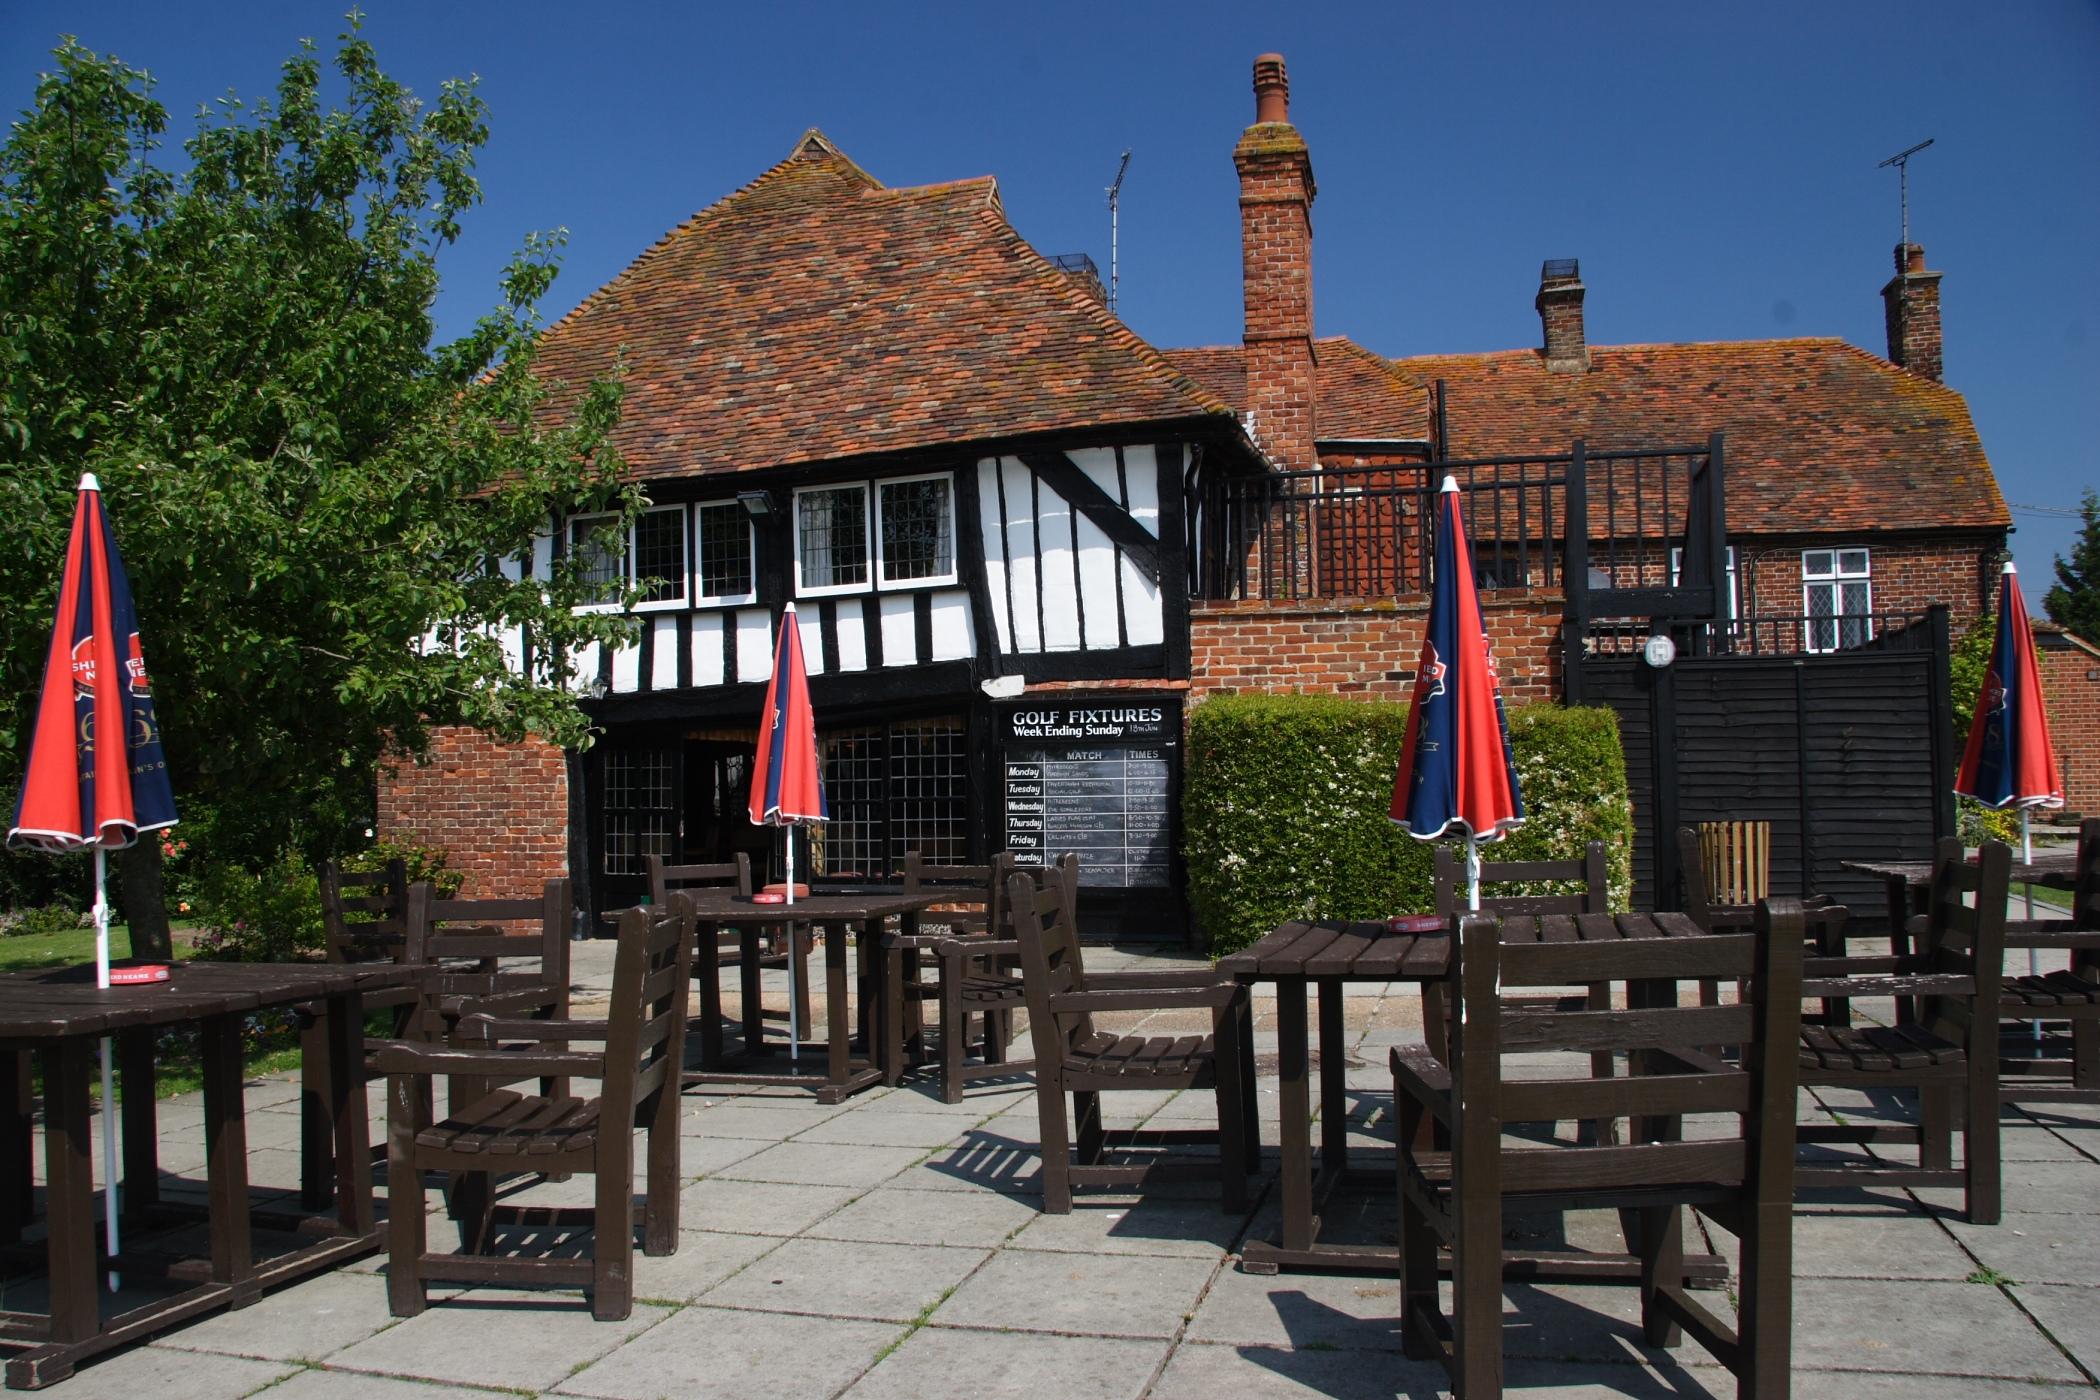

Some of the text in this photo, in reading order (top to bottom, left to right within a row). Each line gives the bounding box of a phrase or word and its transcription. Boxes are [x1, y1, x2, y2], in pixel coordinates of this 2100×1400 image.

[1013, 707, 1163, 725] GOLF FIXTURES
[1013, 723, 1124, 738] Week Ending Sunday
[1066, 751, 1102, 760] MATCH
[1130, 750, 1160, 759] TIMES
[1008, 766, 1040, 779] Monday
[1008, 783, 1041, 796] Tuesday
[1007, 801, 1044, 814] Wednesday
[1009, 817, 1043, 830] Thursday
[1009, 834, 1037, 847] Friday
[1014, 852, 1042, 864] aturday
